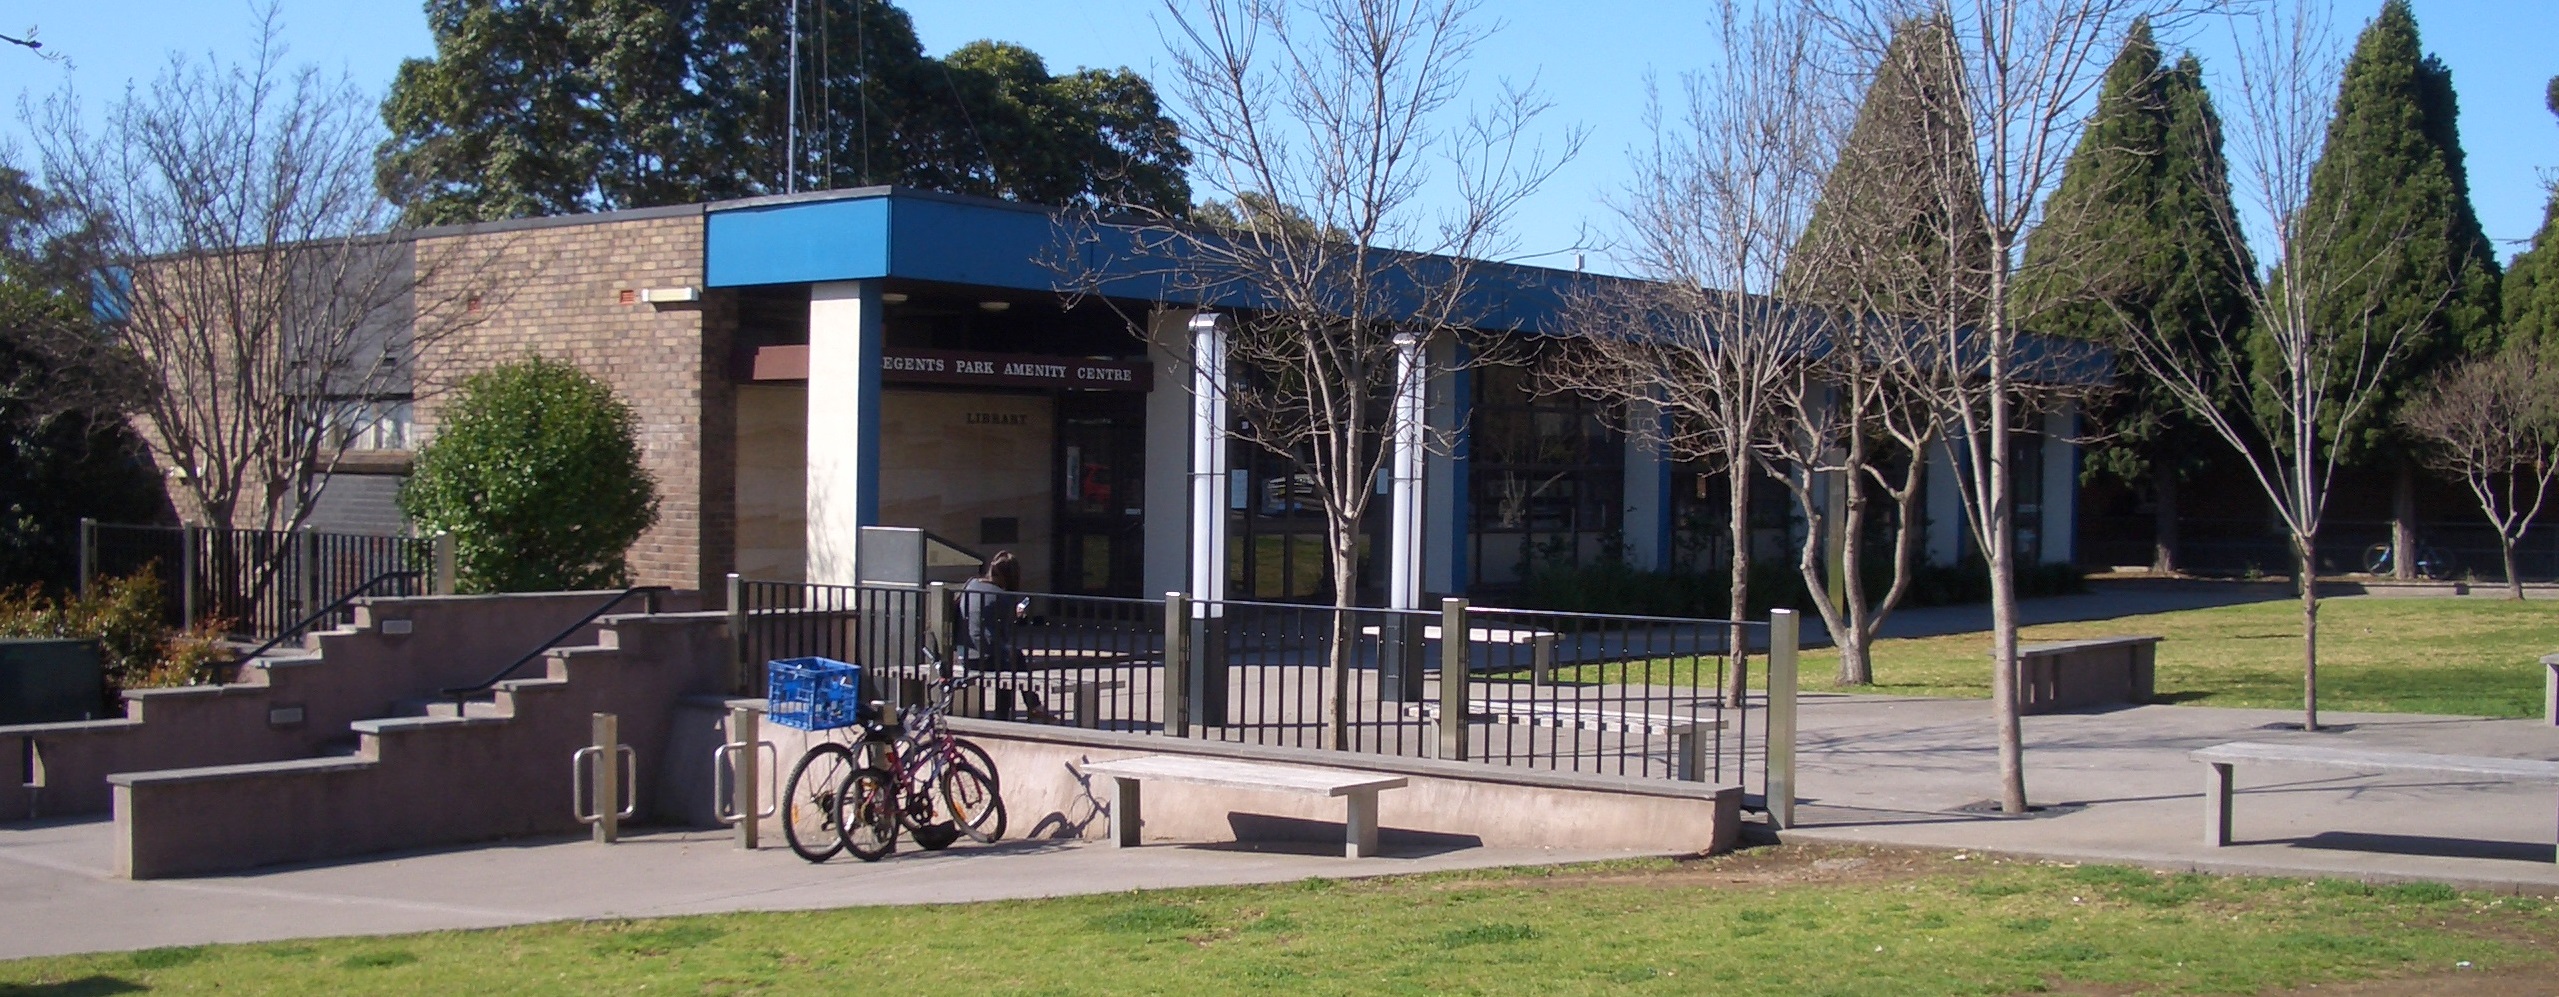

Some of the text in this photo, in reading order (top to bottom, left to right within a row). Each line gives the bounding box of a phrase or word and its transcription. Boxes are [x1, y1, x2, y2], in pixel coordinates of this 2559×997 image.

[881, 356, 1132, 381] EGENTS PARK AMENITY CENTRE
[966, 412, 1028, 425] LIBRARY
